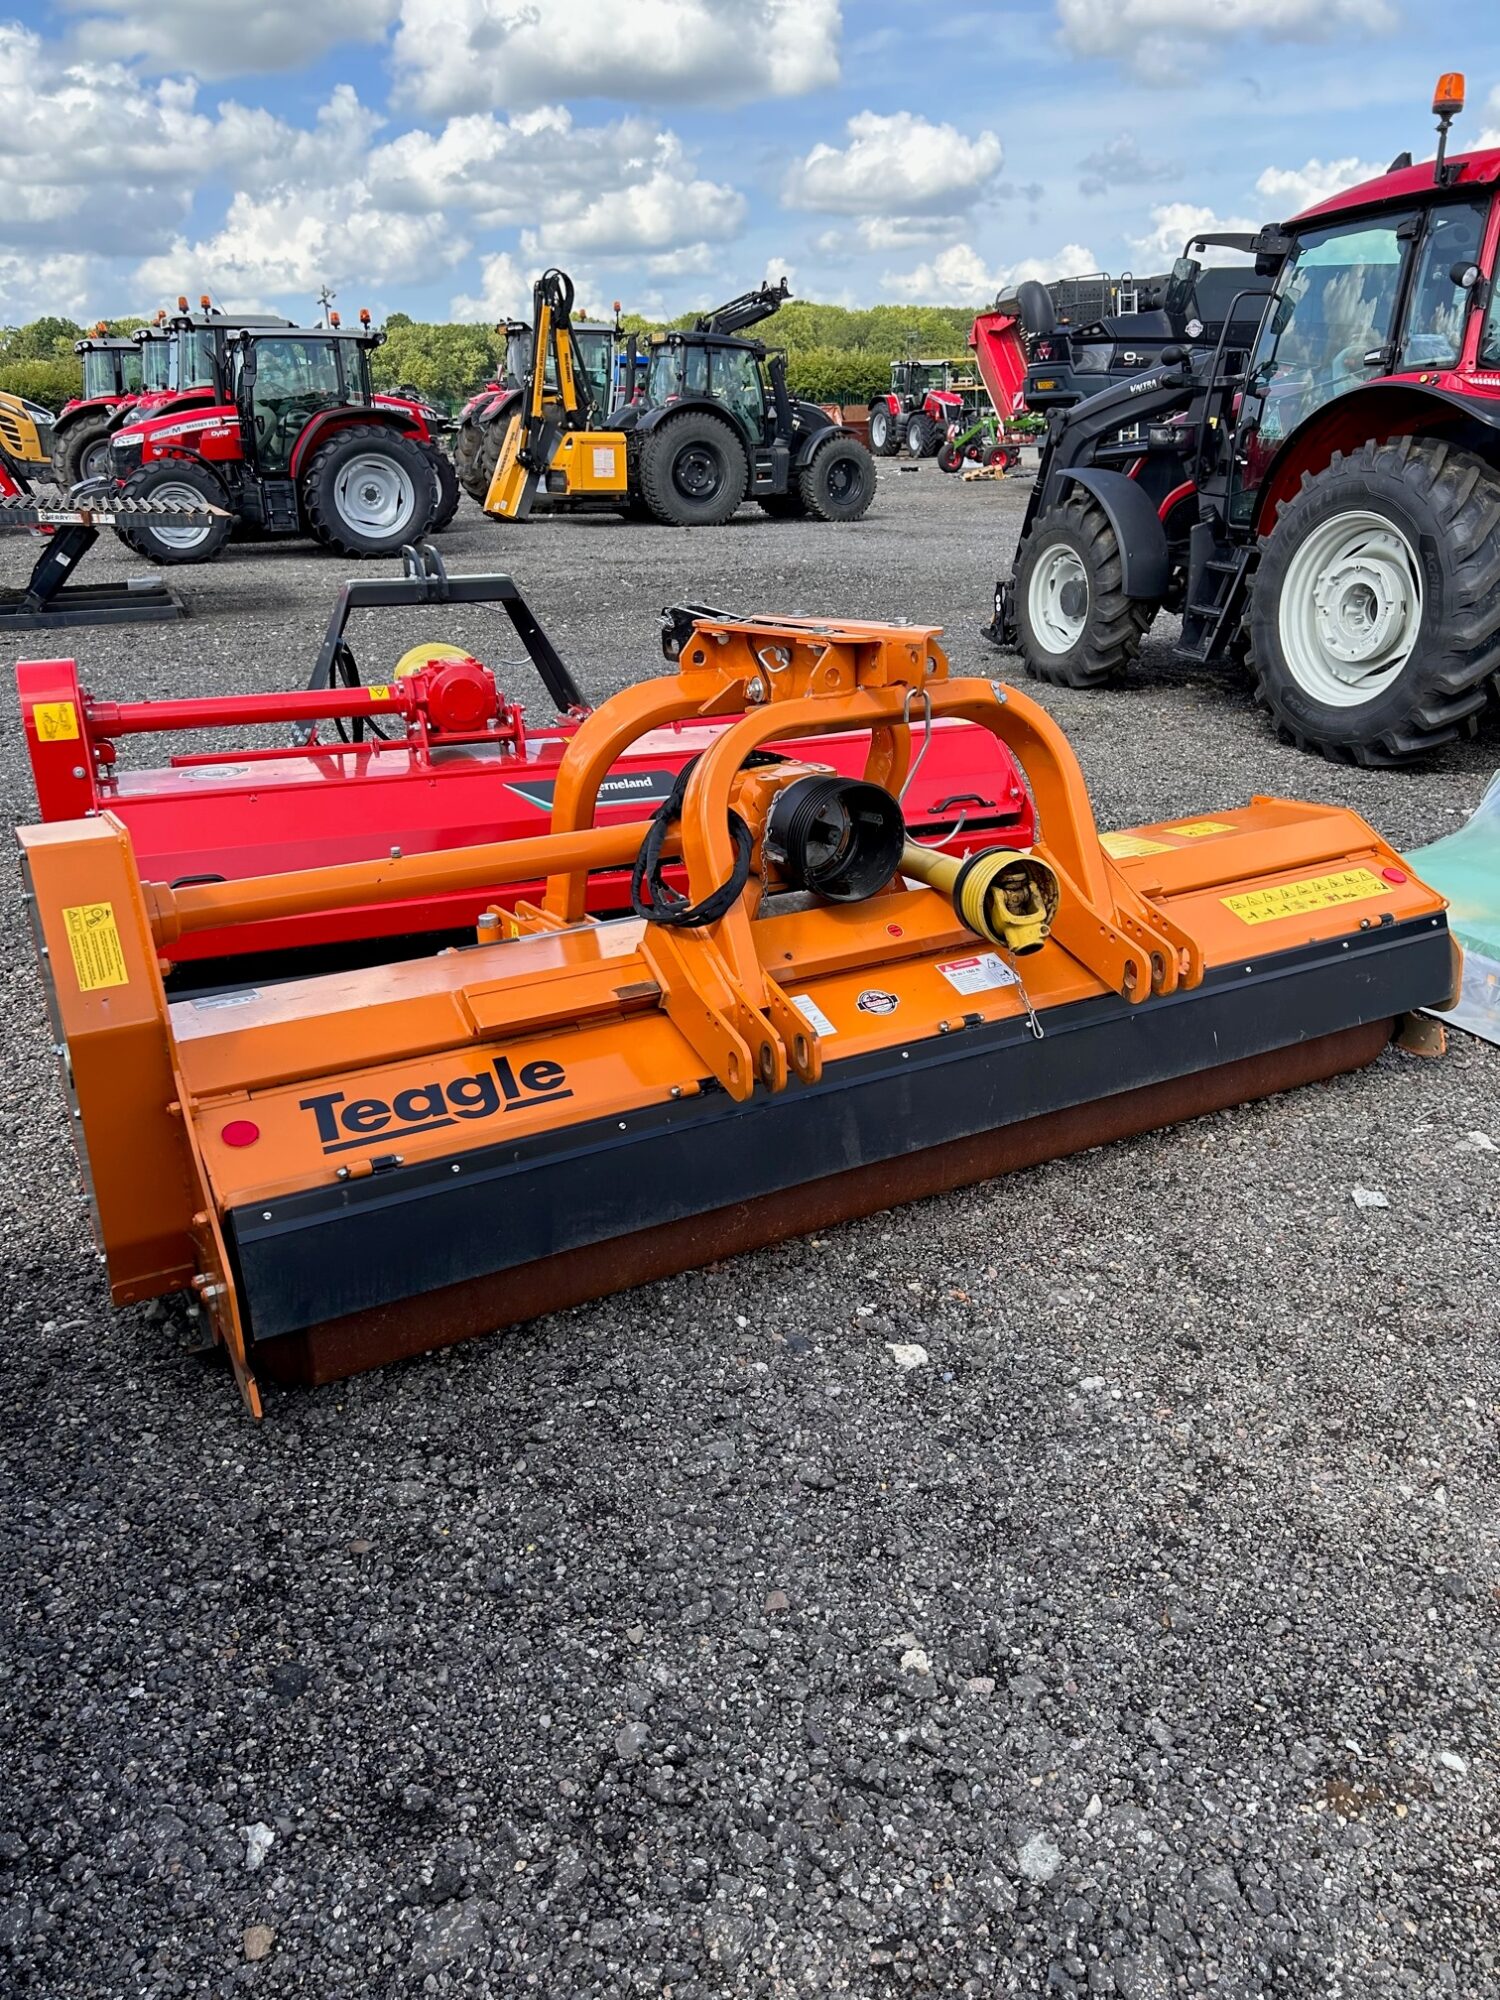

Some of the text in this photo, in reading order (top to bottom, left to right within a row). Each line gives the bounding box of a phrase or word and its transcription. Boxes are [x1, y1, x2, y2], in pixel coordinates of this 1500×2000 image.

[1130, 378, 1157, 393] VALTRA
[1424, 552, 1440, 617] AGRIBIB
[600, 776, 653, 791] erneland
[300, 1056, 566, 1143] Teagle
